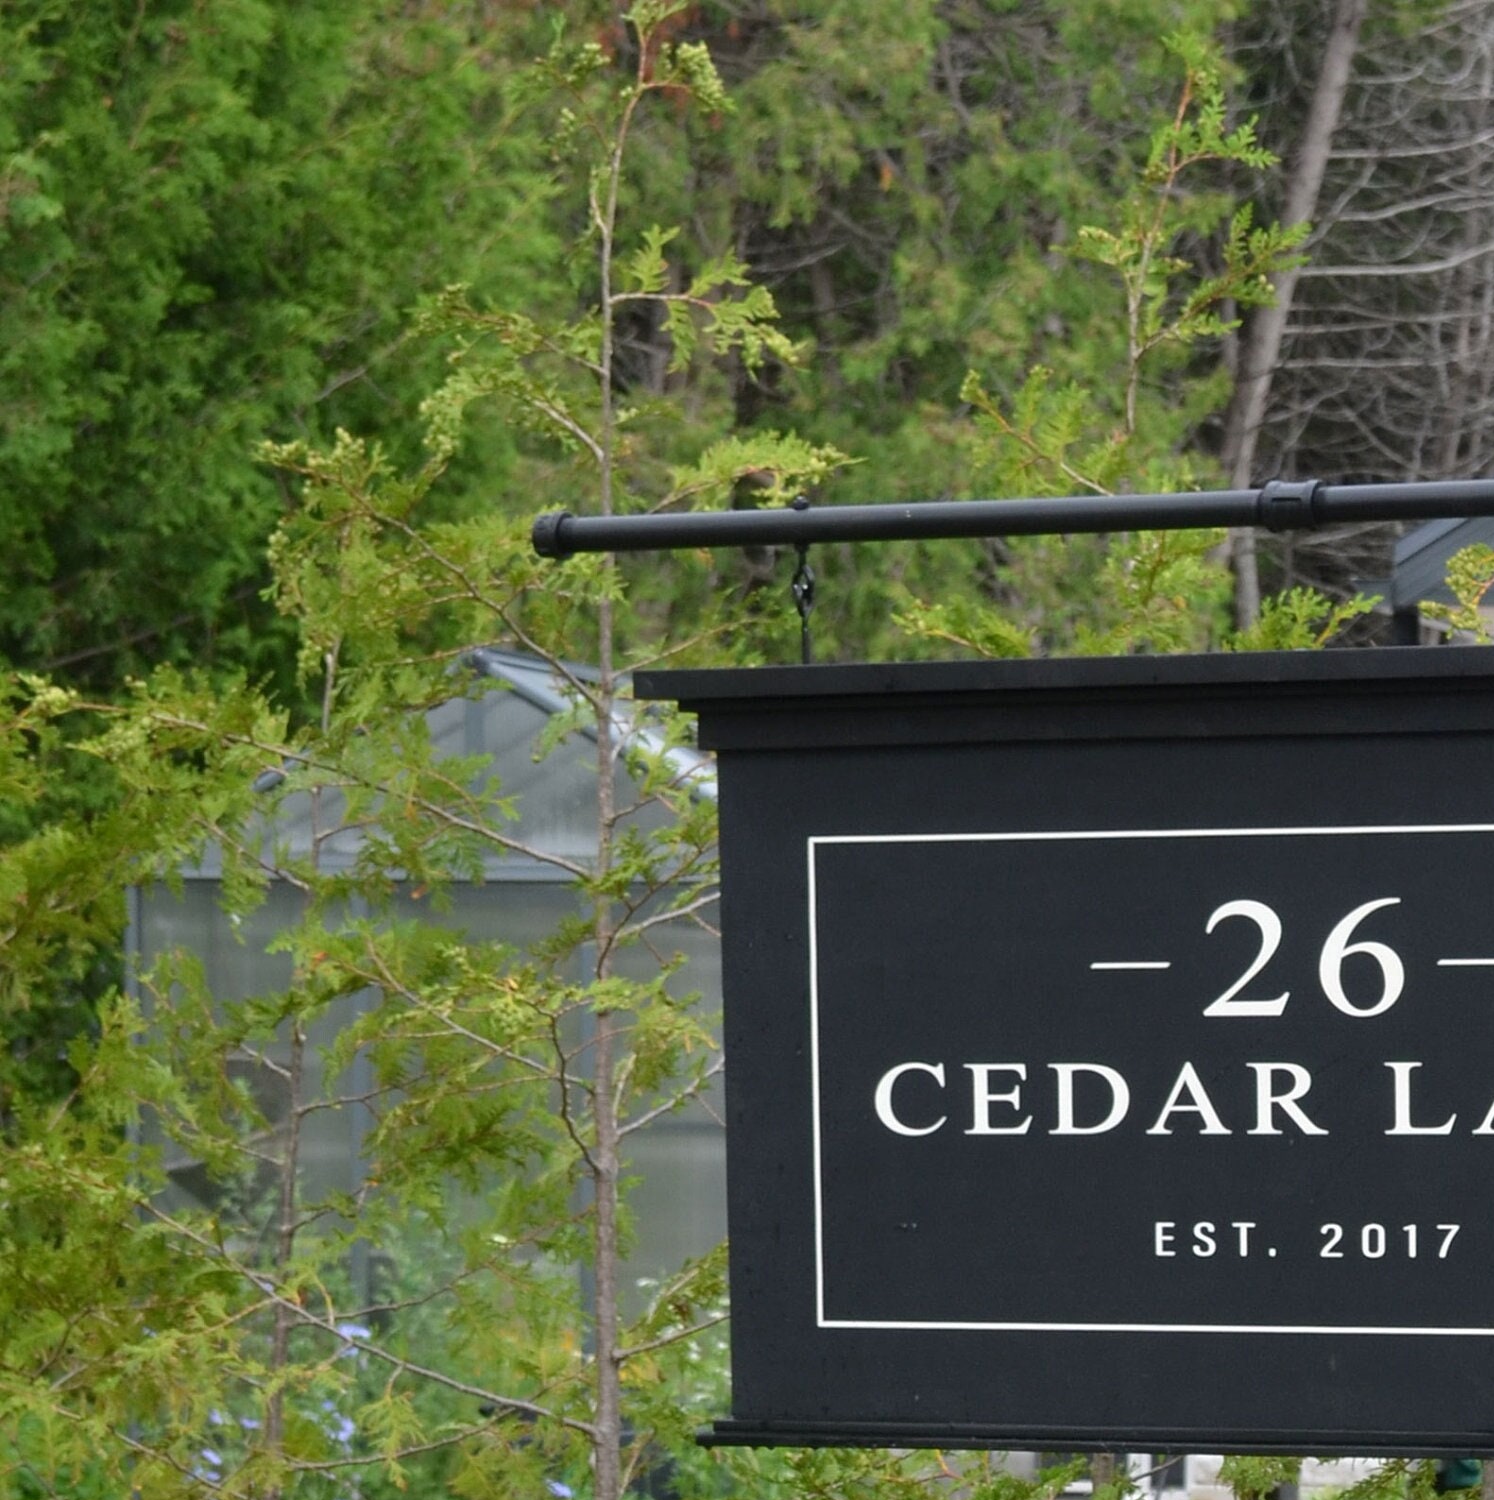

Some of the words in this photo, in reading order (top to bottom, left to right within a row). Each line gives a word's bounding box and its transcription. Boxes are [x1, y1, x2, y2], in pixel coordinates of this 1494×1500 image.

[1203, 897, 1405, 1018] 26
[874, 1061, 1330, 1138] CEDAR
[1153, 1221, 1278, 1259] EST.
[1319, 1222, 1462, 1259] 2017
